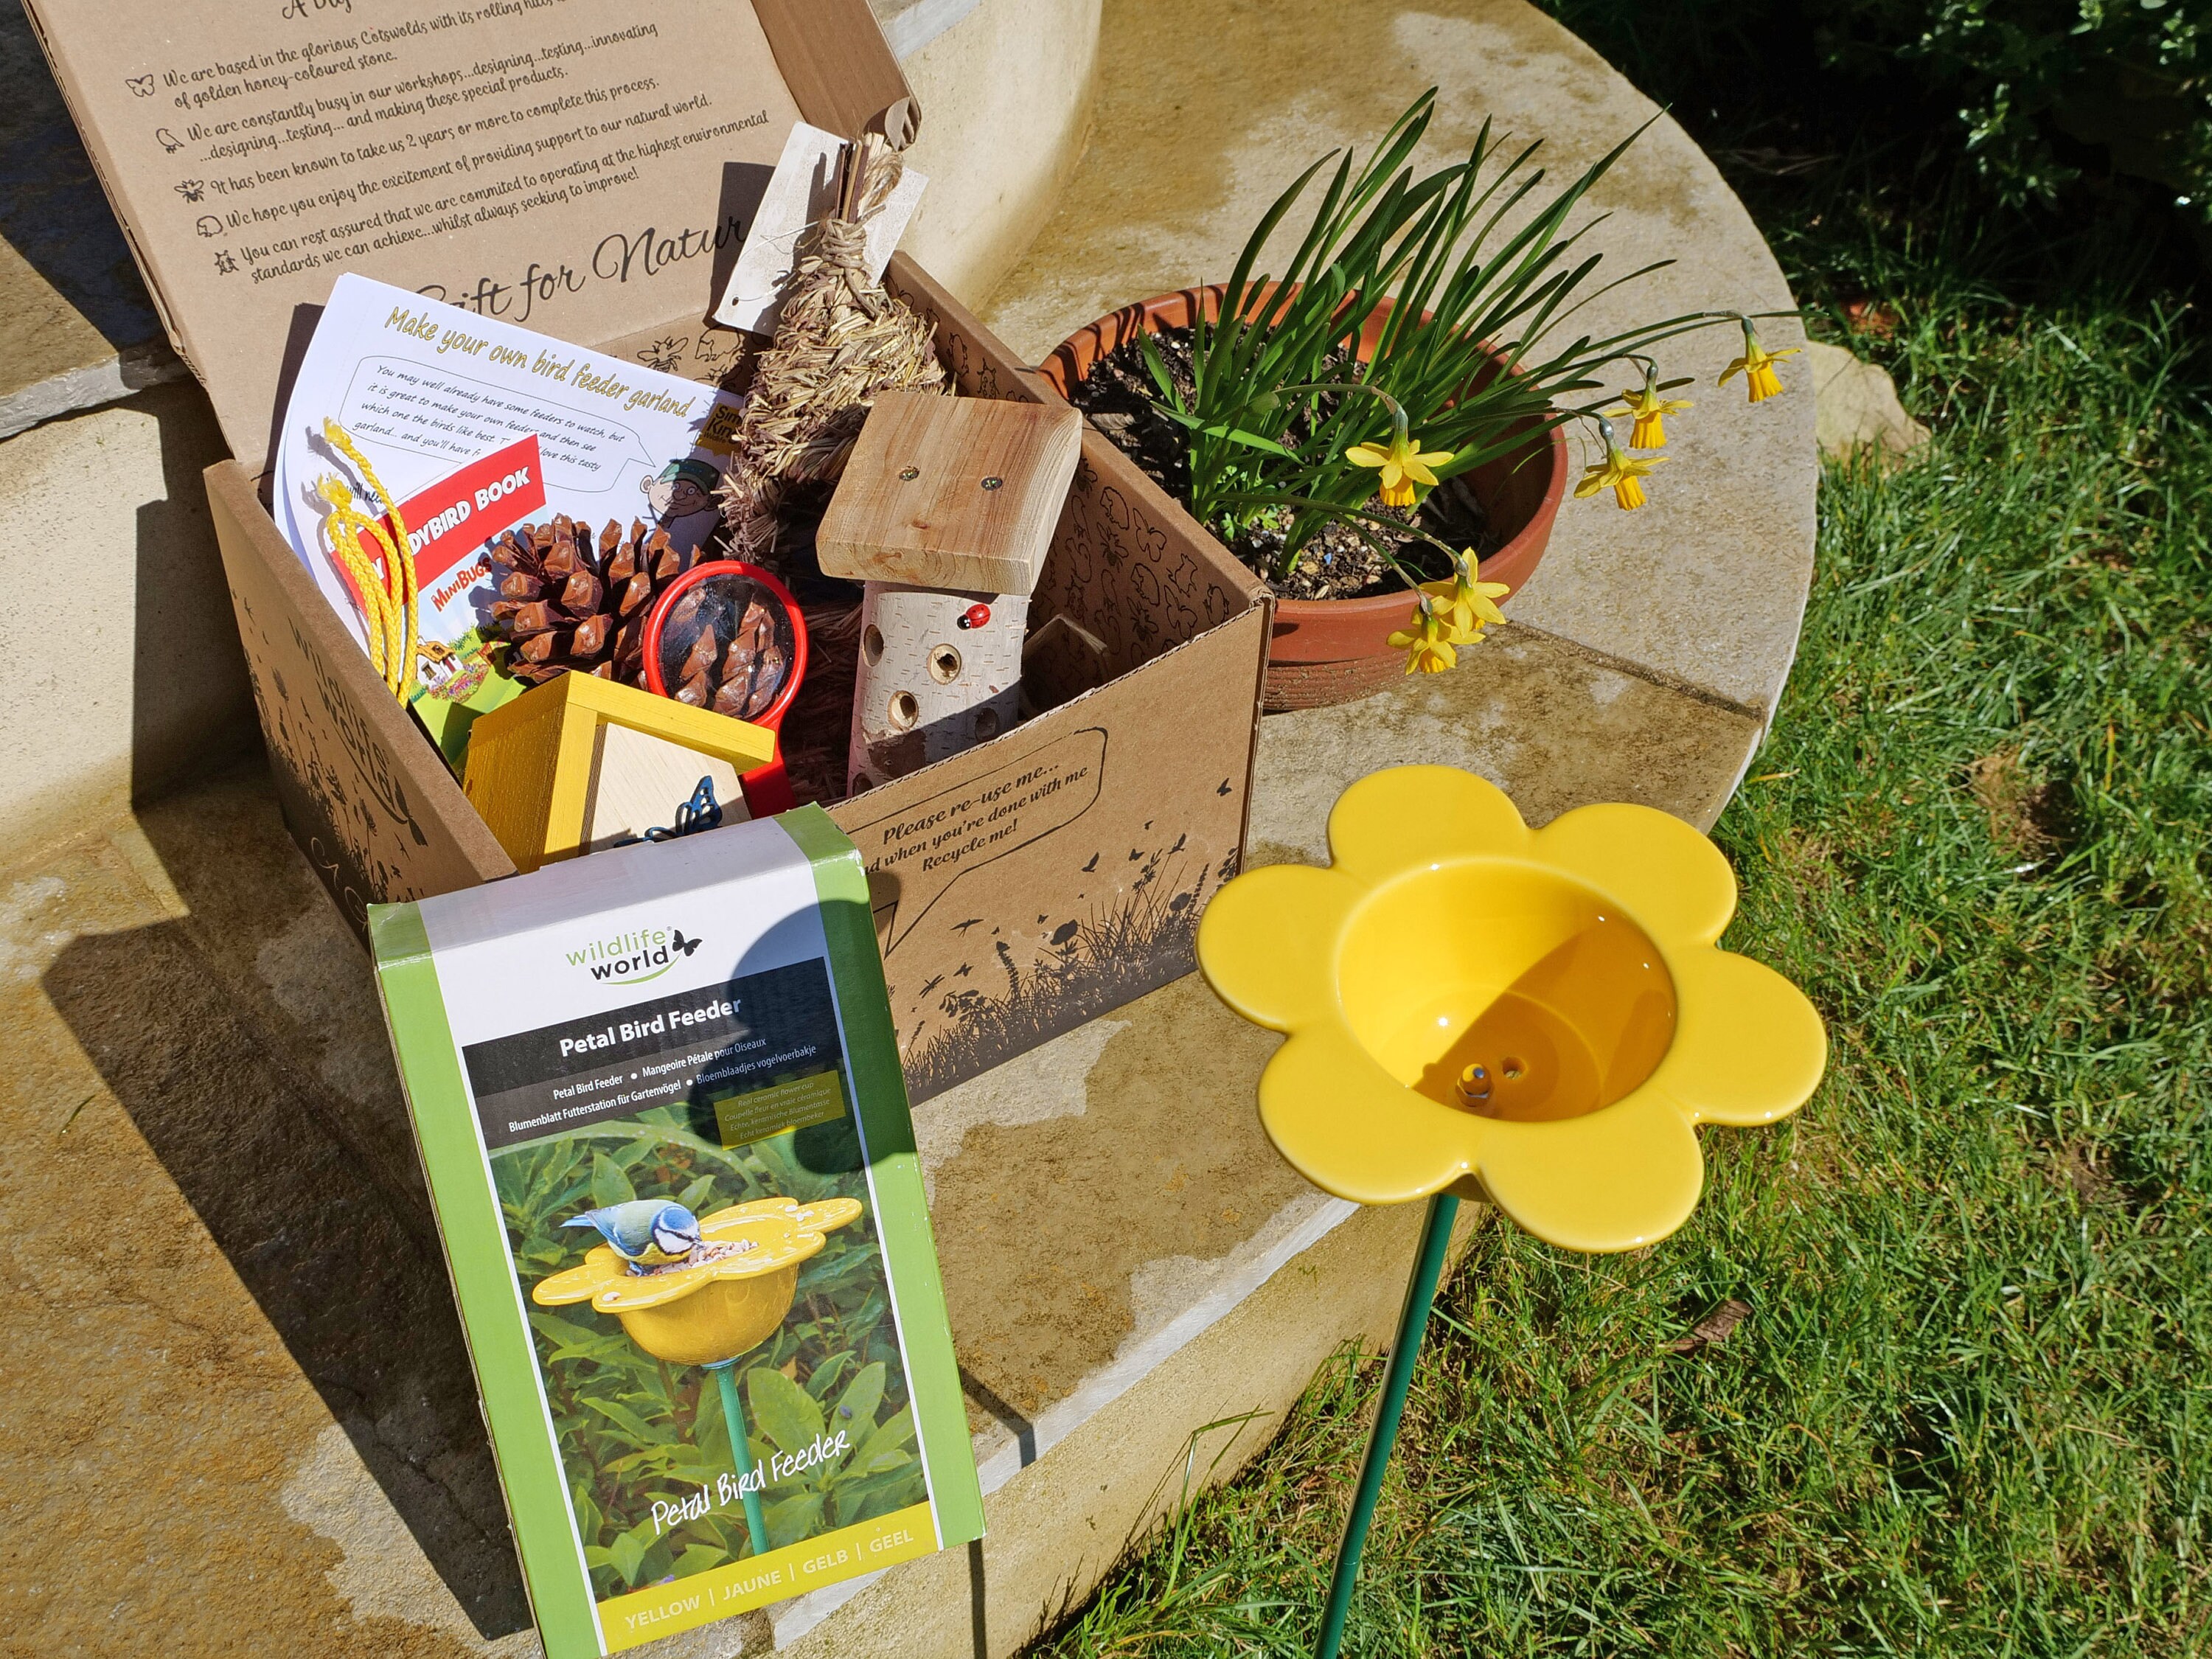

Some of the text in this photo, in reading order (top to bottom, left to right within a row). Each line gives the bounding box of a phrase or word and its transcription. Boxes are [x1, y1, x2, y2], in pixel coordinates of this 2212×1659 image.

[162, 69, 189, 87] We
[190, 68, 215, 81] are
[214, 54, 259, 76] based
[257, 53, 274, 67] in
[275, 48, 299, 64] the
[301, 37, 358, 63] glorious
[360, 19, 428, 45] Cotswolds
[428, 13, 458, 30] with
[456, 10, 474, 24] its
[475, 1, 523, 20] rolling
[174, 51, 397, 110] of golden honey-coloured stone.
[186, 122, 213, 141] We
[214, 121, 240, 135] are
[240, 101, 316, 128] constantly
[314, 96, 350, 111] busy
[349, 91, 366, 105] in
[368, 86, 392, 100] our
[346, 108, 373, 127] and
[374, 100, 425, 120] making
[425, 91, 460, 108] these
[461, 76, 507, 102] special
[507, 66, 568, 92] products.
[239, 108, 769, 265] You can rest assured that we are commited to operating at the highest environmental
[251, 165, 639, 285] standards we can achieve...whilst always seeking to improve!
[514, 263, 585, 322] for
[592, 215, 747, 283] Natur
[384, 306, 695, 417] Make your own bird feeder garland
[361, 402, 389, 414] which
[391, 411, 410, 420] one
[411, 414, 429, 425] the
[429, 417, 456, 432] birds
[455, 425, 473, 437] like
[474, 429, 495, 442] best.
[540, 447, 559, 459] love
[559, 453, 578, 464] this
[577, 459, 602, 472] tasty
[366, 381, 378, 392] it
[378, 384, 389, 394] is
[386, 391, 417, 402] great
[417, 396, 430, 406] to
[430, 401, 459, 414] make
[456, 409, 484, 420] your
[482, 416, 504, 426] own
[538, 431, 561, 441] and
[558, 436, 580, 447] then
[580, 443, 597, 451] see
[376, 364, 625, 442] You may well already have some feeders to watch, but
[351, 422, 397, 437] garland...
[400, 433, 423, 442] and
[419, 438, 451, 449] you'll
[448, 442, 471, 455] have
[408, 466, 531, 556] DYBIRD BOOK
[864, 766, 1088, 876] nd when you're done with me
[883, 764, 1059, 845] Please re-use me...
[922, 817, 1018, 872] Recycle me!
[591, 945, 669, 981] world
[560, 999, 740, 1057] Petal Bird Feeder
[509, 1045, 815, 1132] Blumenblatt Futterstation für Gartenvögel Bloemblaadjes vogelvoerbakje
[553, 1038, 765, 1099] Petal Bird Feeder Mangeoire Pétale pour Oiseaux
[738, 1097, 752, 1107] Real
[754, 1091, 779, 1102] ceramic
[780, 1085, 800, 1096] flower
[724, 1108, 753, 1121] Coupelle
[754, 1103, 768, 1113] fleur
[779, 1097, 796, 1106] vraie
[797, 1088, 830, 1102] céramique
[730, 1099, 830, 1130] Echte, keramische Blumentasse
[740, 1111, 824, 1139] Echt keramiek bloembeker
[625, 1529, 913, 1628] YELLOW JAUNE GELB GEEL
